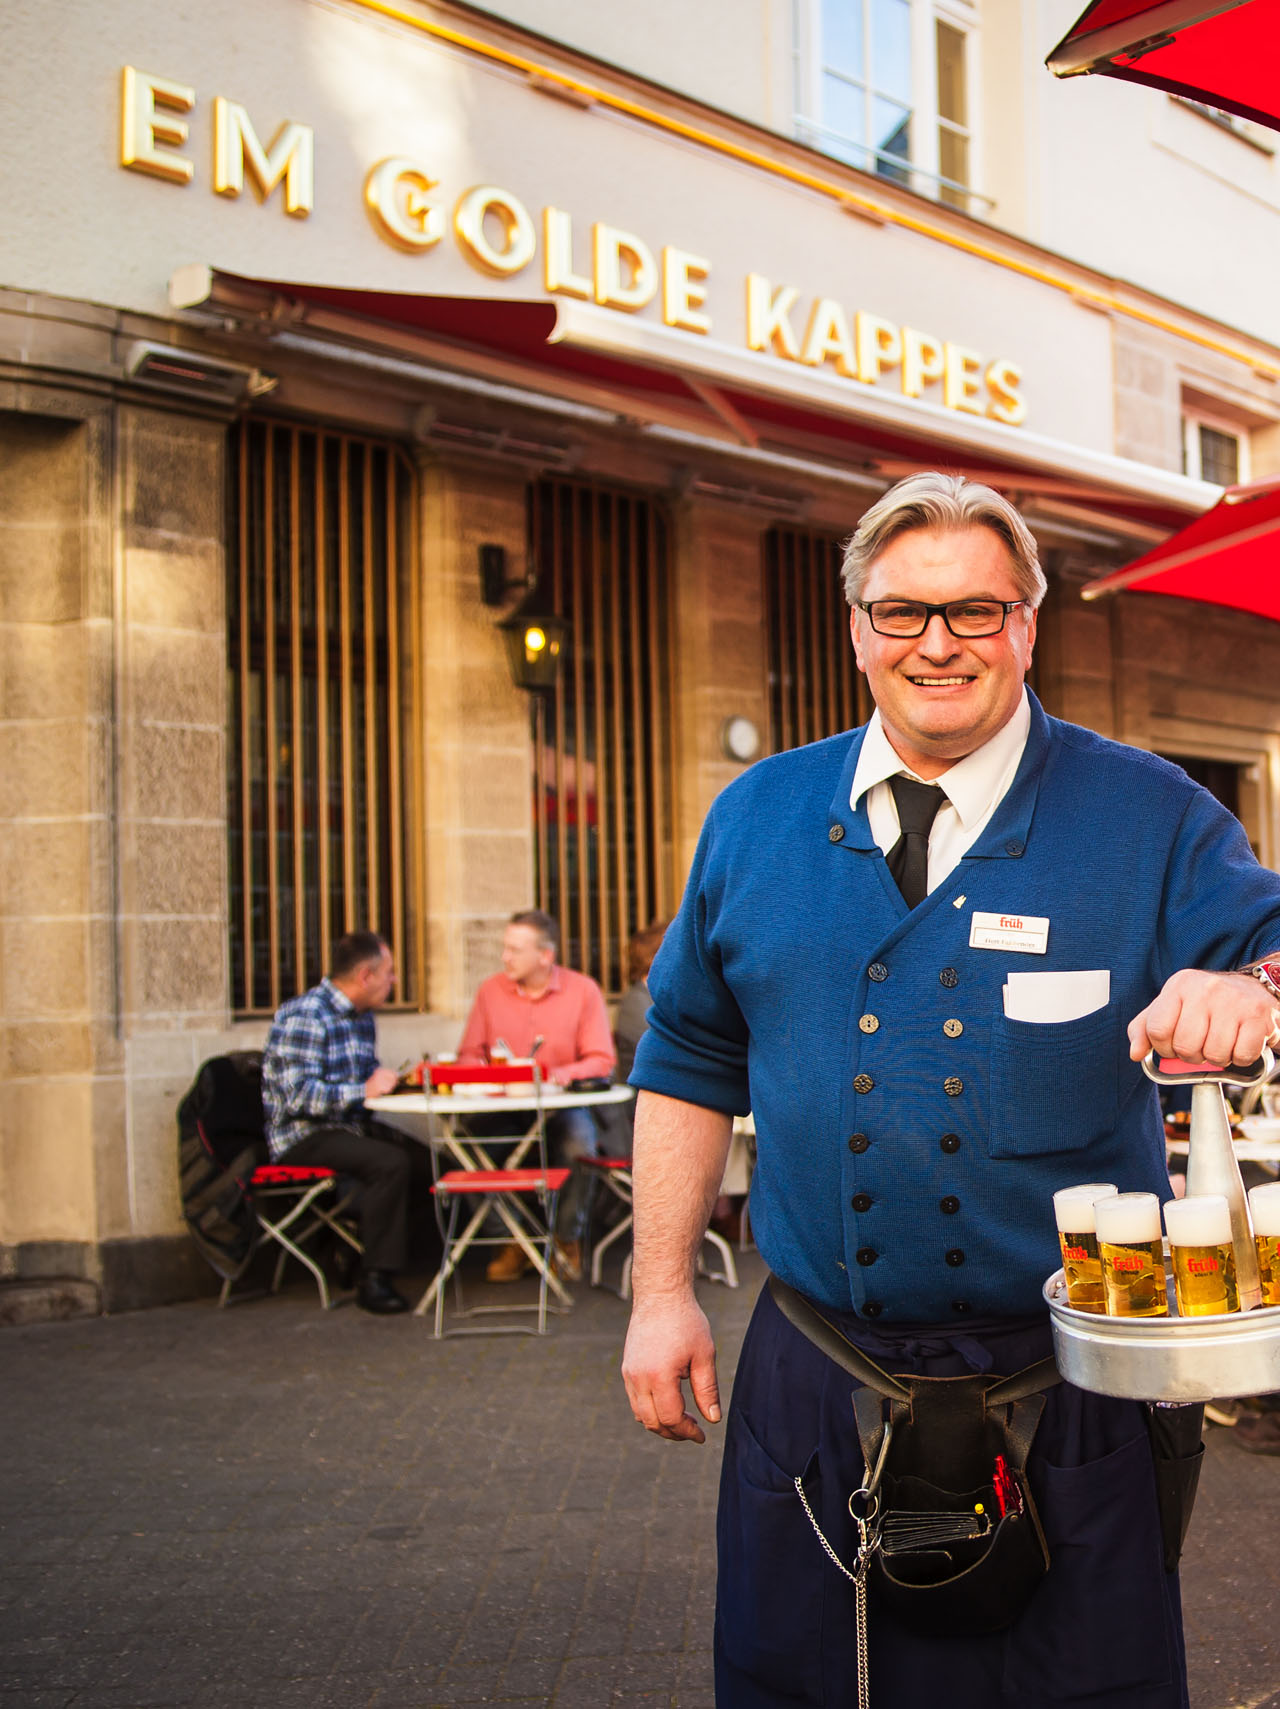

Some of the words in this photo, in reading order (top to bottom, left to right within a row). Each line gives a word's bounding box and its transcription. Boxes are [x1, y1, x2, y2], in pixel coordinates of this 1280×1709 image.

[120, 64, 314, 221] EM
[364, 155, 713, 336] GOLDE
[746, 271, 1028, 427] KAPPES
[1000, 916, 1023, 929] früh
[1112, 1255, 1144, 1271] früh
[1187, 1256, 1219, 1272] früh
